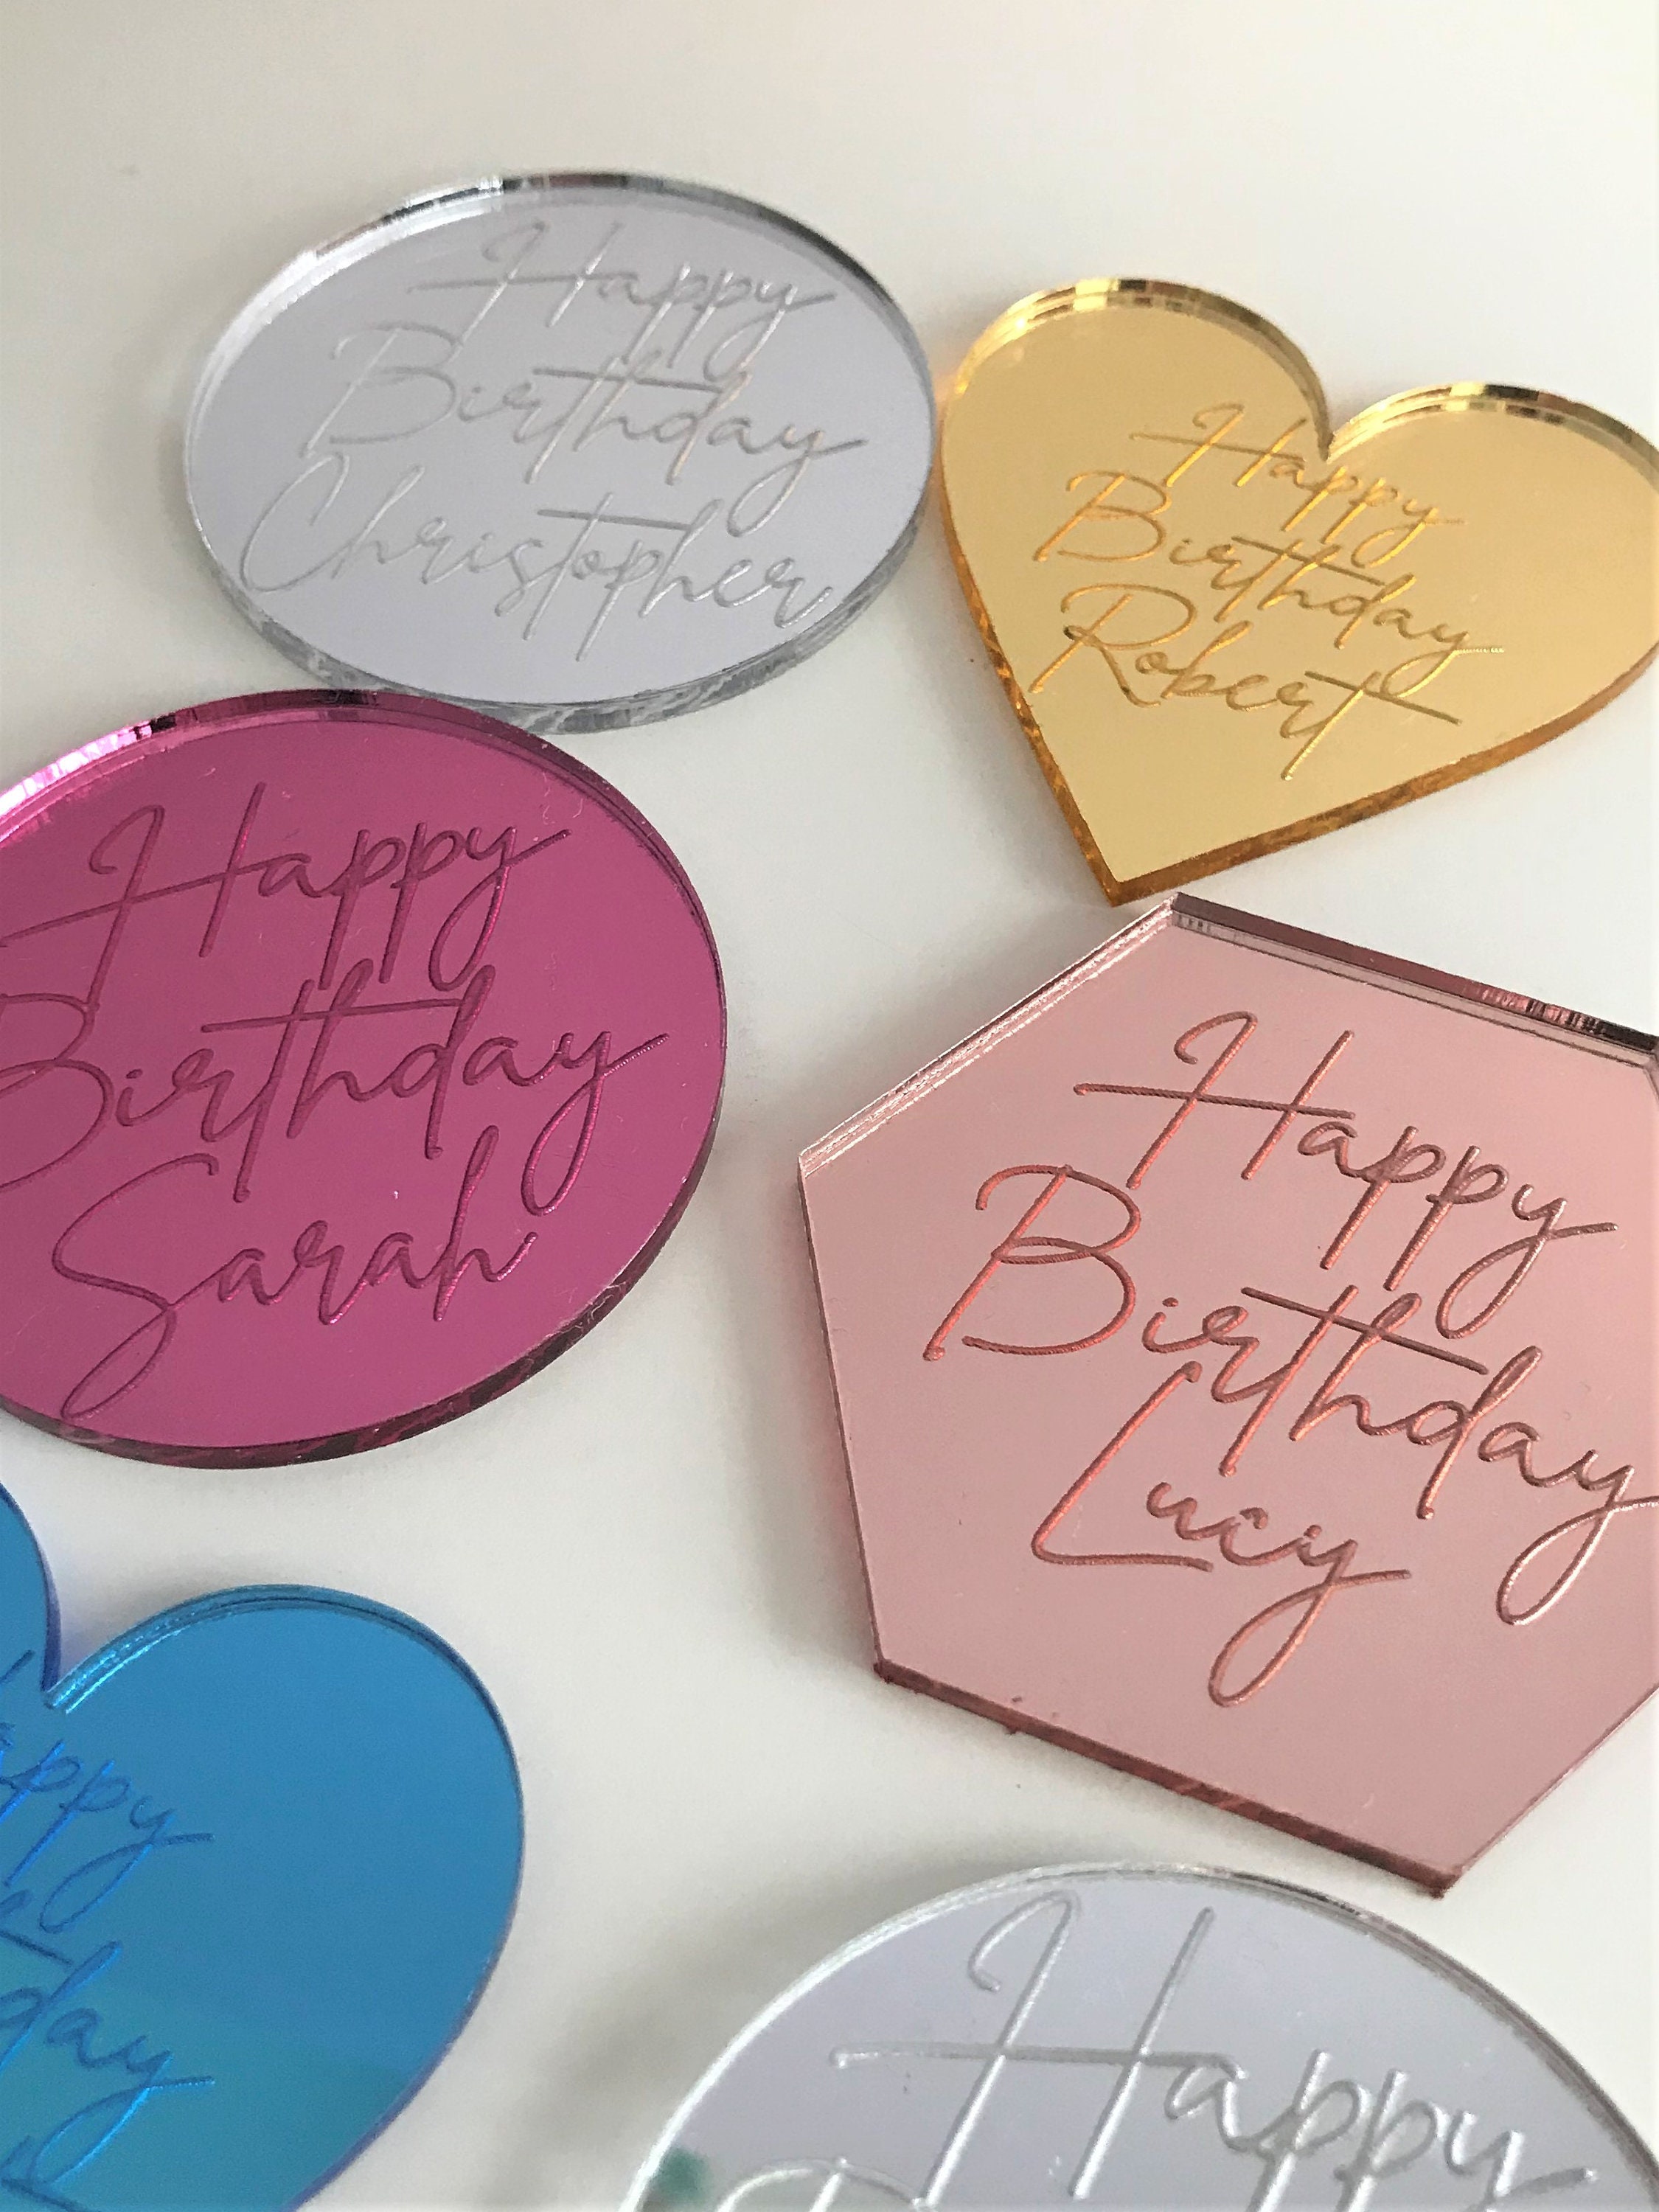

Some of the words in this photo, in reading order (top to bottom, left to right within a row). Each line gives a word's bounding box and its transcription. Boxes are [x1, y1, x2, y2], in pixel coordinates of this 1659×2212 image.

[407, 220, 835, 383] Happy
[299, 319, 868, 538] Birthday
[1129, 402, 1466, 567] Happy
[239, 451, 835, 662] Christopher
[1033, 470, 1505, 699] Birthday
[1029, 583, 1462, 780] Robert
[0, 782, 571, 992] Happy
[52, 1125, 538, 1421] Sarah
[1074, 1011, 1618, 1339] Happy
[923, 1164, 1659, 1625] Birthday
[1032, 1360, 1411, 1706] Lucy
[0, 1649, 215, 1933] ppy
[830, 1890, 1597, 2212] Happy
